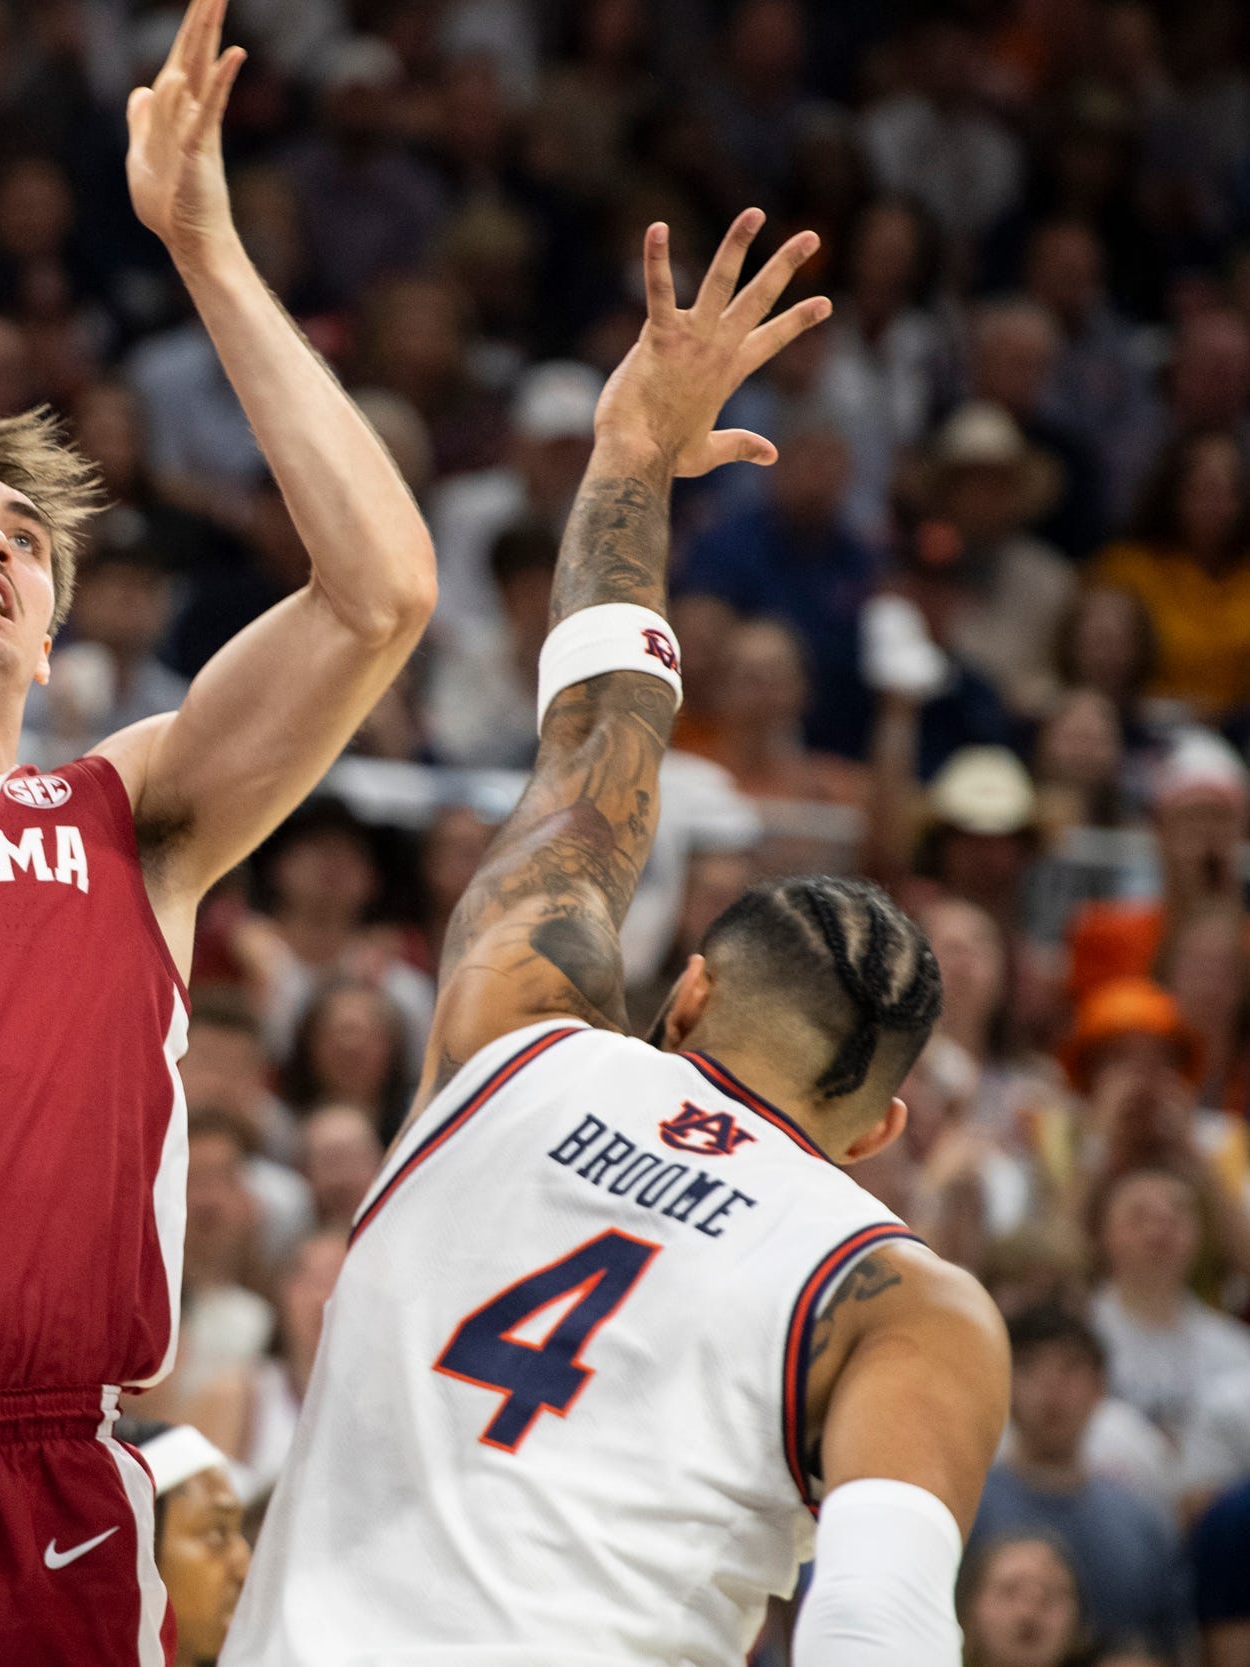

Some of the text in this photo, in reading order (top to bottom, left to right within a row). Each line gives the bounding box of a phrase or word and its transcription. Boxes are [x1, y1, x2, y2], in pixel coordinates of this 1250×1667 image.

[8, 777, 68, 806] SEC
[547, 1112, 757, 1238] BROOME
[431, 1226, 664, 1456] 4
